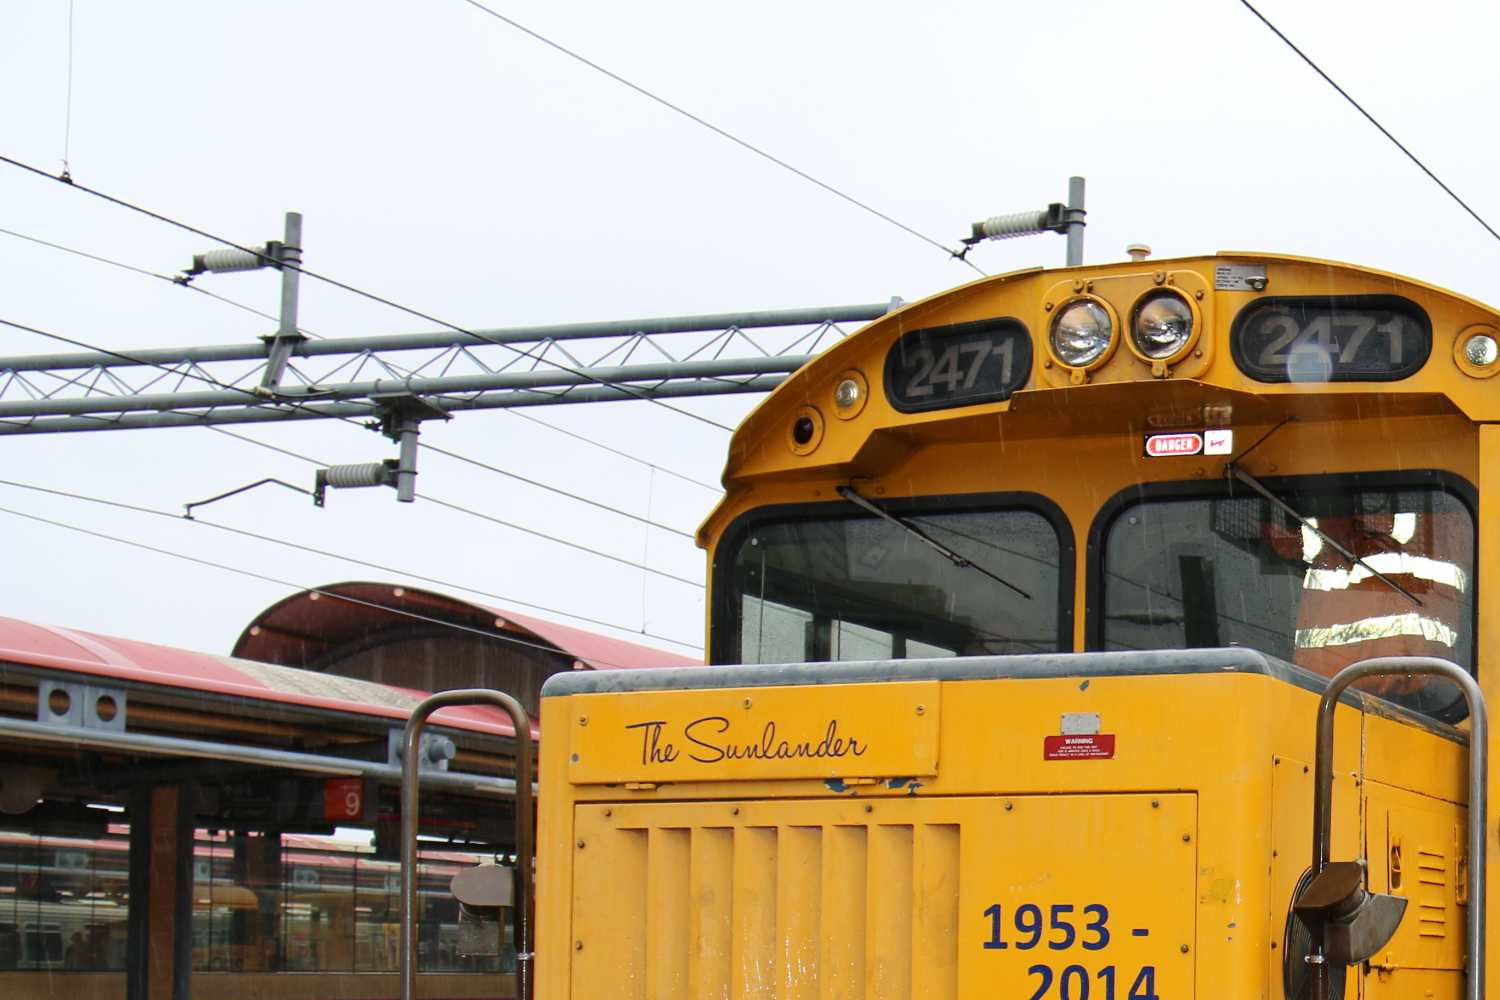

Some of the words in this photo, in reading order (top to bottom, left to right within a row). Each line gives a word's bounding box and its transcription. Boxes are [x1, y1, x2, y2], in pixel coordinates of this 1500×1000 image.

[1258, 313, 1404, 365] 2471
[904, 336, 1014, 398] 2471
[1154, 437, 1194, 453] DANGER
[625, 720, 680, 766] The
[684, 716, 868, 764] Sunlander
[344, 791, 360, 816] 9
[982, 903, 1110, 951] 1953
